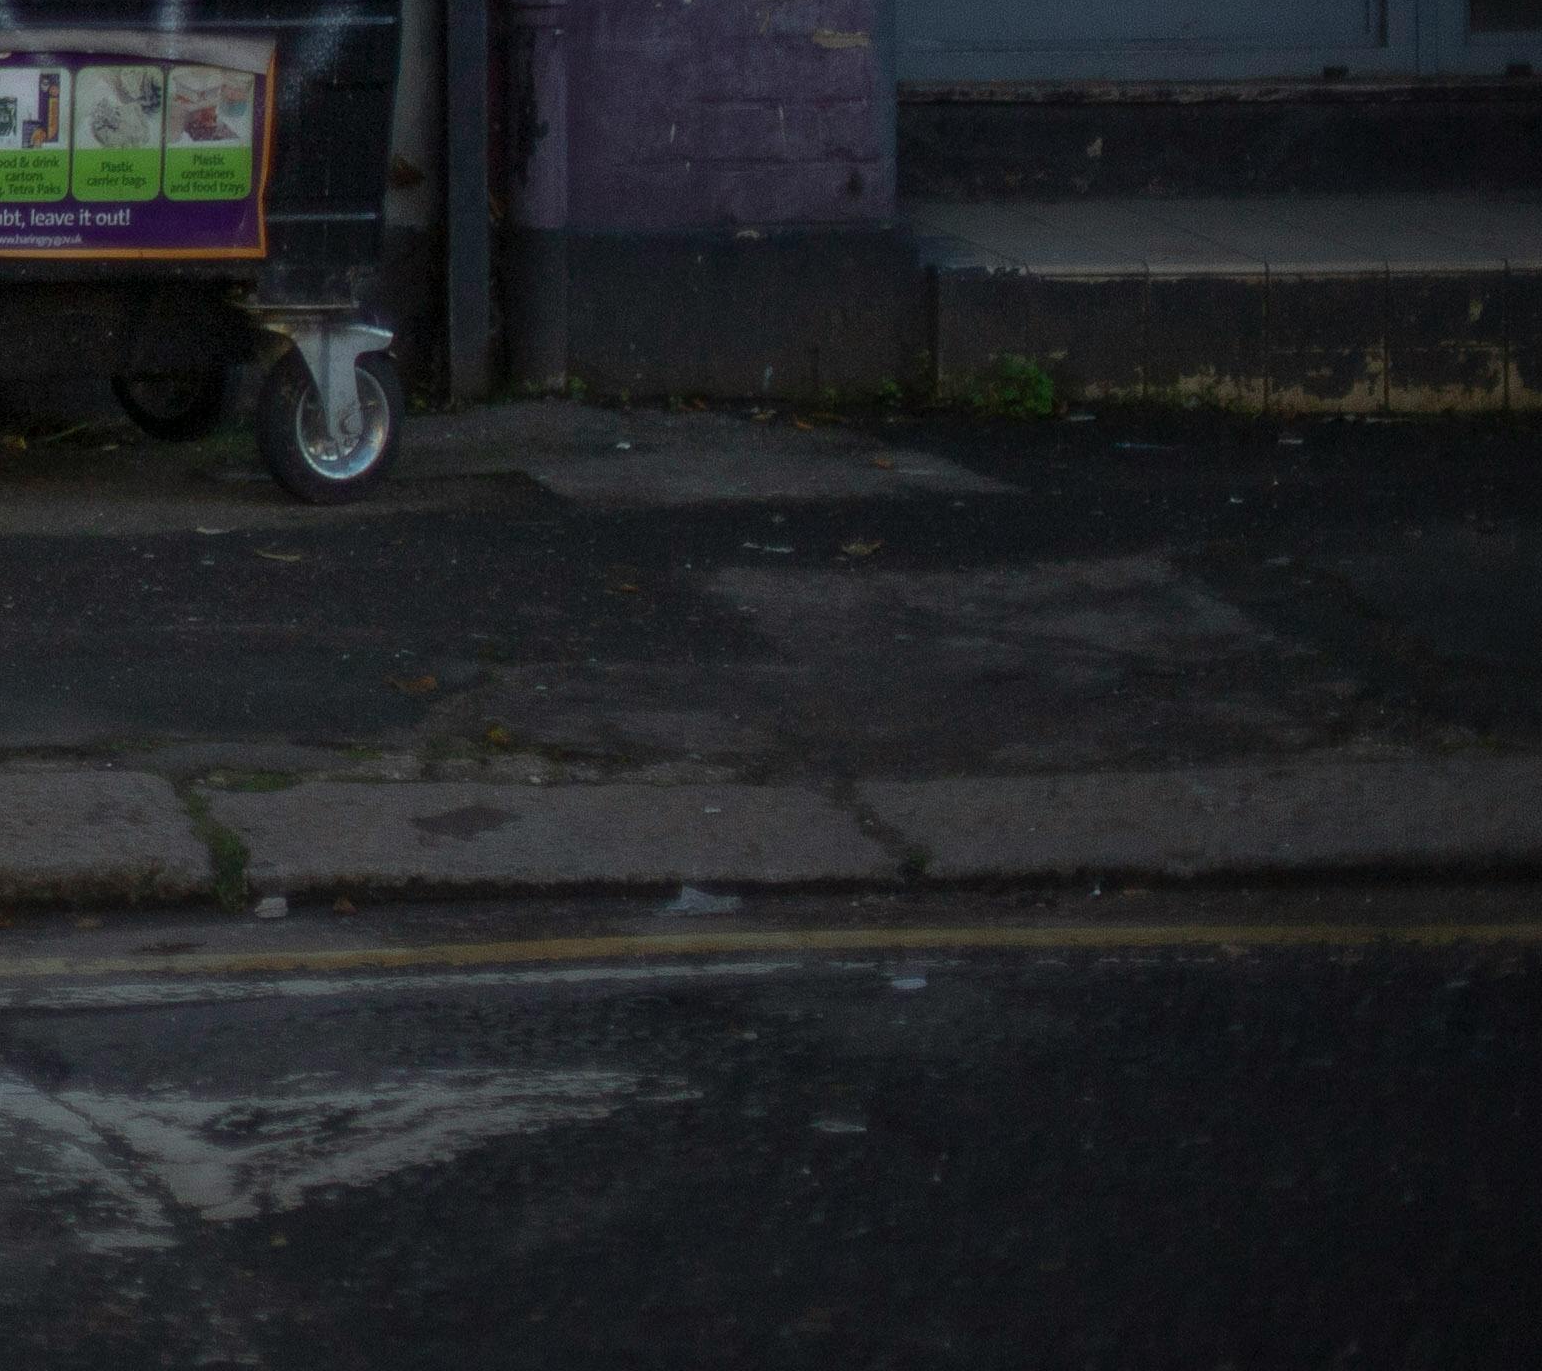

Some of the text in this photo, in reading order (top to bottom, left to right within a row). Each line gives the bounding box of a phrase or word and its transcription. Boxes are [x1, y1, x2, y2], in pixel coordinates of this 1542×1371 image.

[32, 156, 59, 168] drink
[192, 154, 225, 165] Plastic
[101, 162, 134, 173] Plastic
[5, 171, 44, 182] cartons
[182, 168, 235, 181] containers
[8, 183, 34, 195] Tetra
[170, 181, 245, 195] and food trays
[30, 209, 75, 226] leave
[79, 208, 93, 226] it
[95, 208, 130, 226] out!
